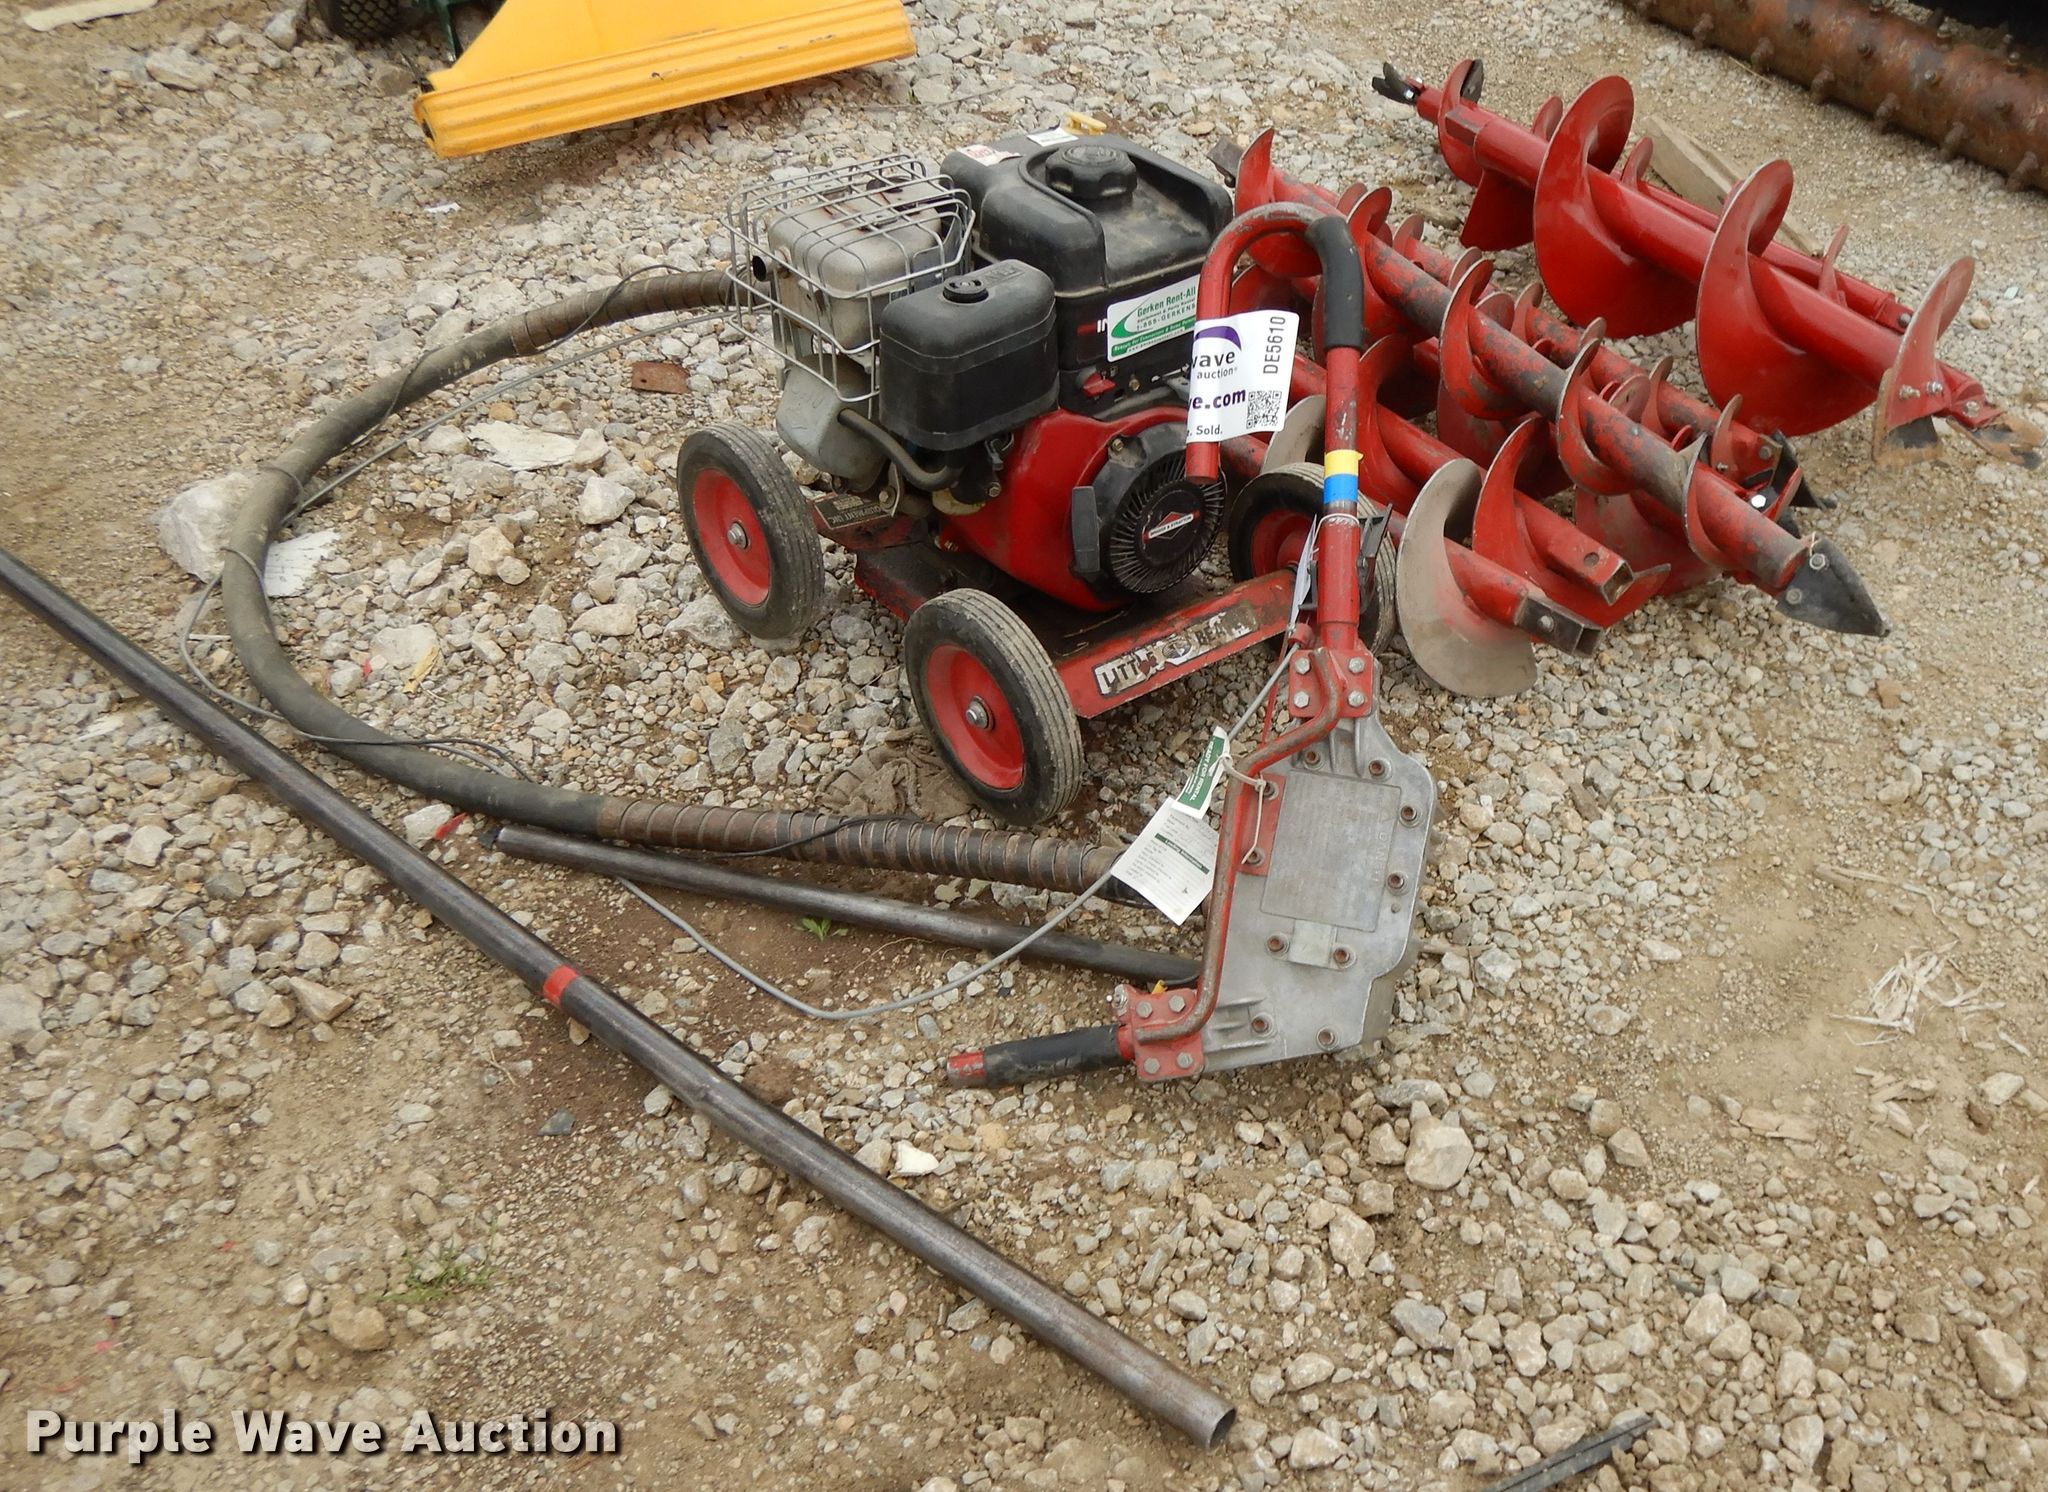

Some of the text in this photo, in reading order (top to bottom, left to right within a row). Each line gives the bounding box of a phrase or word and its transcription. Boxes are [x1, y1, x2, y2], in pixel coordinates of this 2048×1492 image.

[1137, 286, 1196, 318] Gerken Rent-All
[1262, 316, 1286, 375] DE5610
[1190, 389, 1247, 410] e.com
[1196, 424, 1223, 436] Sold.
